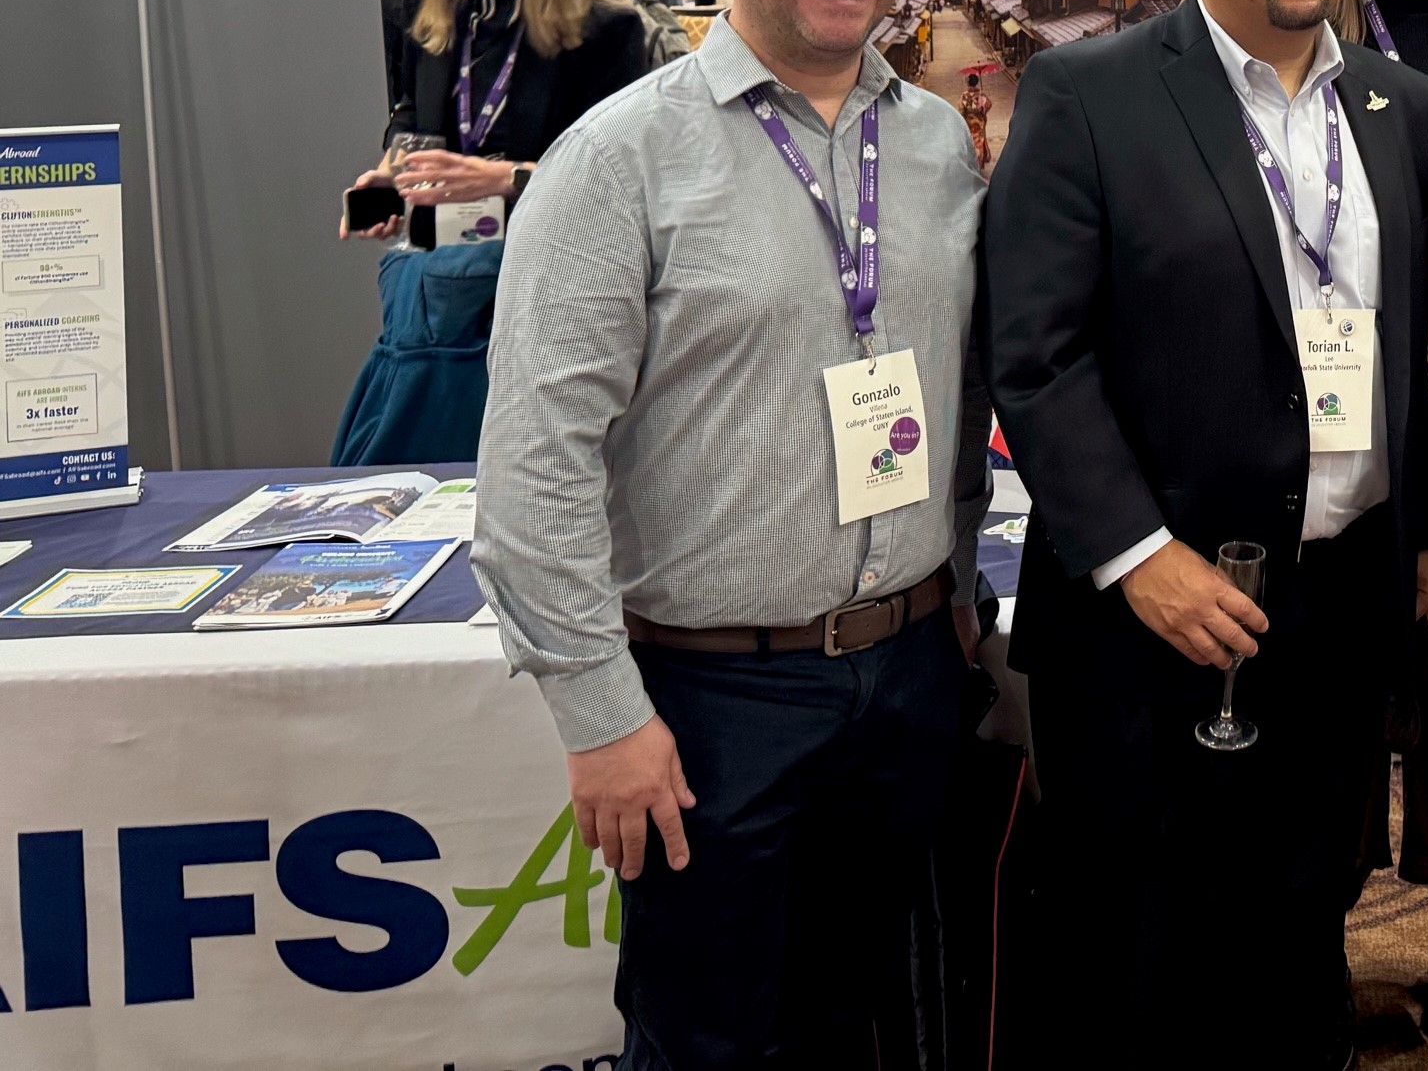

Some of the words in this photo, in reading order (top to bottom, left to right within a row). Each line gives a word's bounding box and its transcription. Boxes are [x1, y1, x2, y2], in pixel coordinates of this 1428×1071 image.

[0, 146, 41, 159] Abroad
[781, 143, 801, 168] FORUM
[0, 162, 96, 186] ERNSHIPS
[799, 167, 811, 182] THE
[61, 314, 100, 325] COACHING
[1307, 340, 1341, 353] Torian
[1344, 340, 1354, 353] L.
[1334, 364, 1361, 372] University
[33, 387, 60, 396] ABROAD
[852, 383, 901, 406] Gonzalo
[26, 408, 40, 420] 3x
[44, 405, 79, 418] faster
[869, 403, 888, 414] Villena
[845, 417, 867, 429] College
[868, 415, 875, 423] of
[876, 412, 894, 421] Staten
[872, 422, 889, 432] CUNY
[890, 431, 900, 440] Are
[900, 432, 911, 440] you
[911, 431, 920, 439] in?
[62, 452, 99, 465] CONTACT
[866, 477, 879, 486] THE
[881, 470, 904, 482] FORUM
